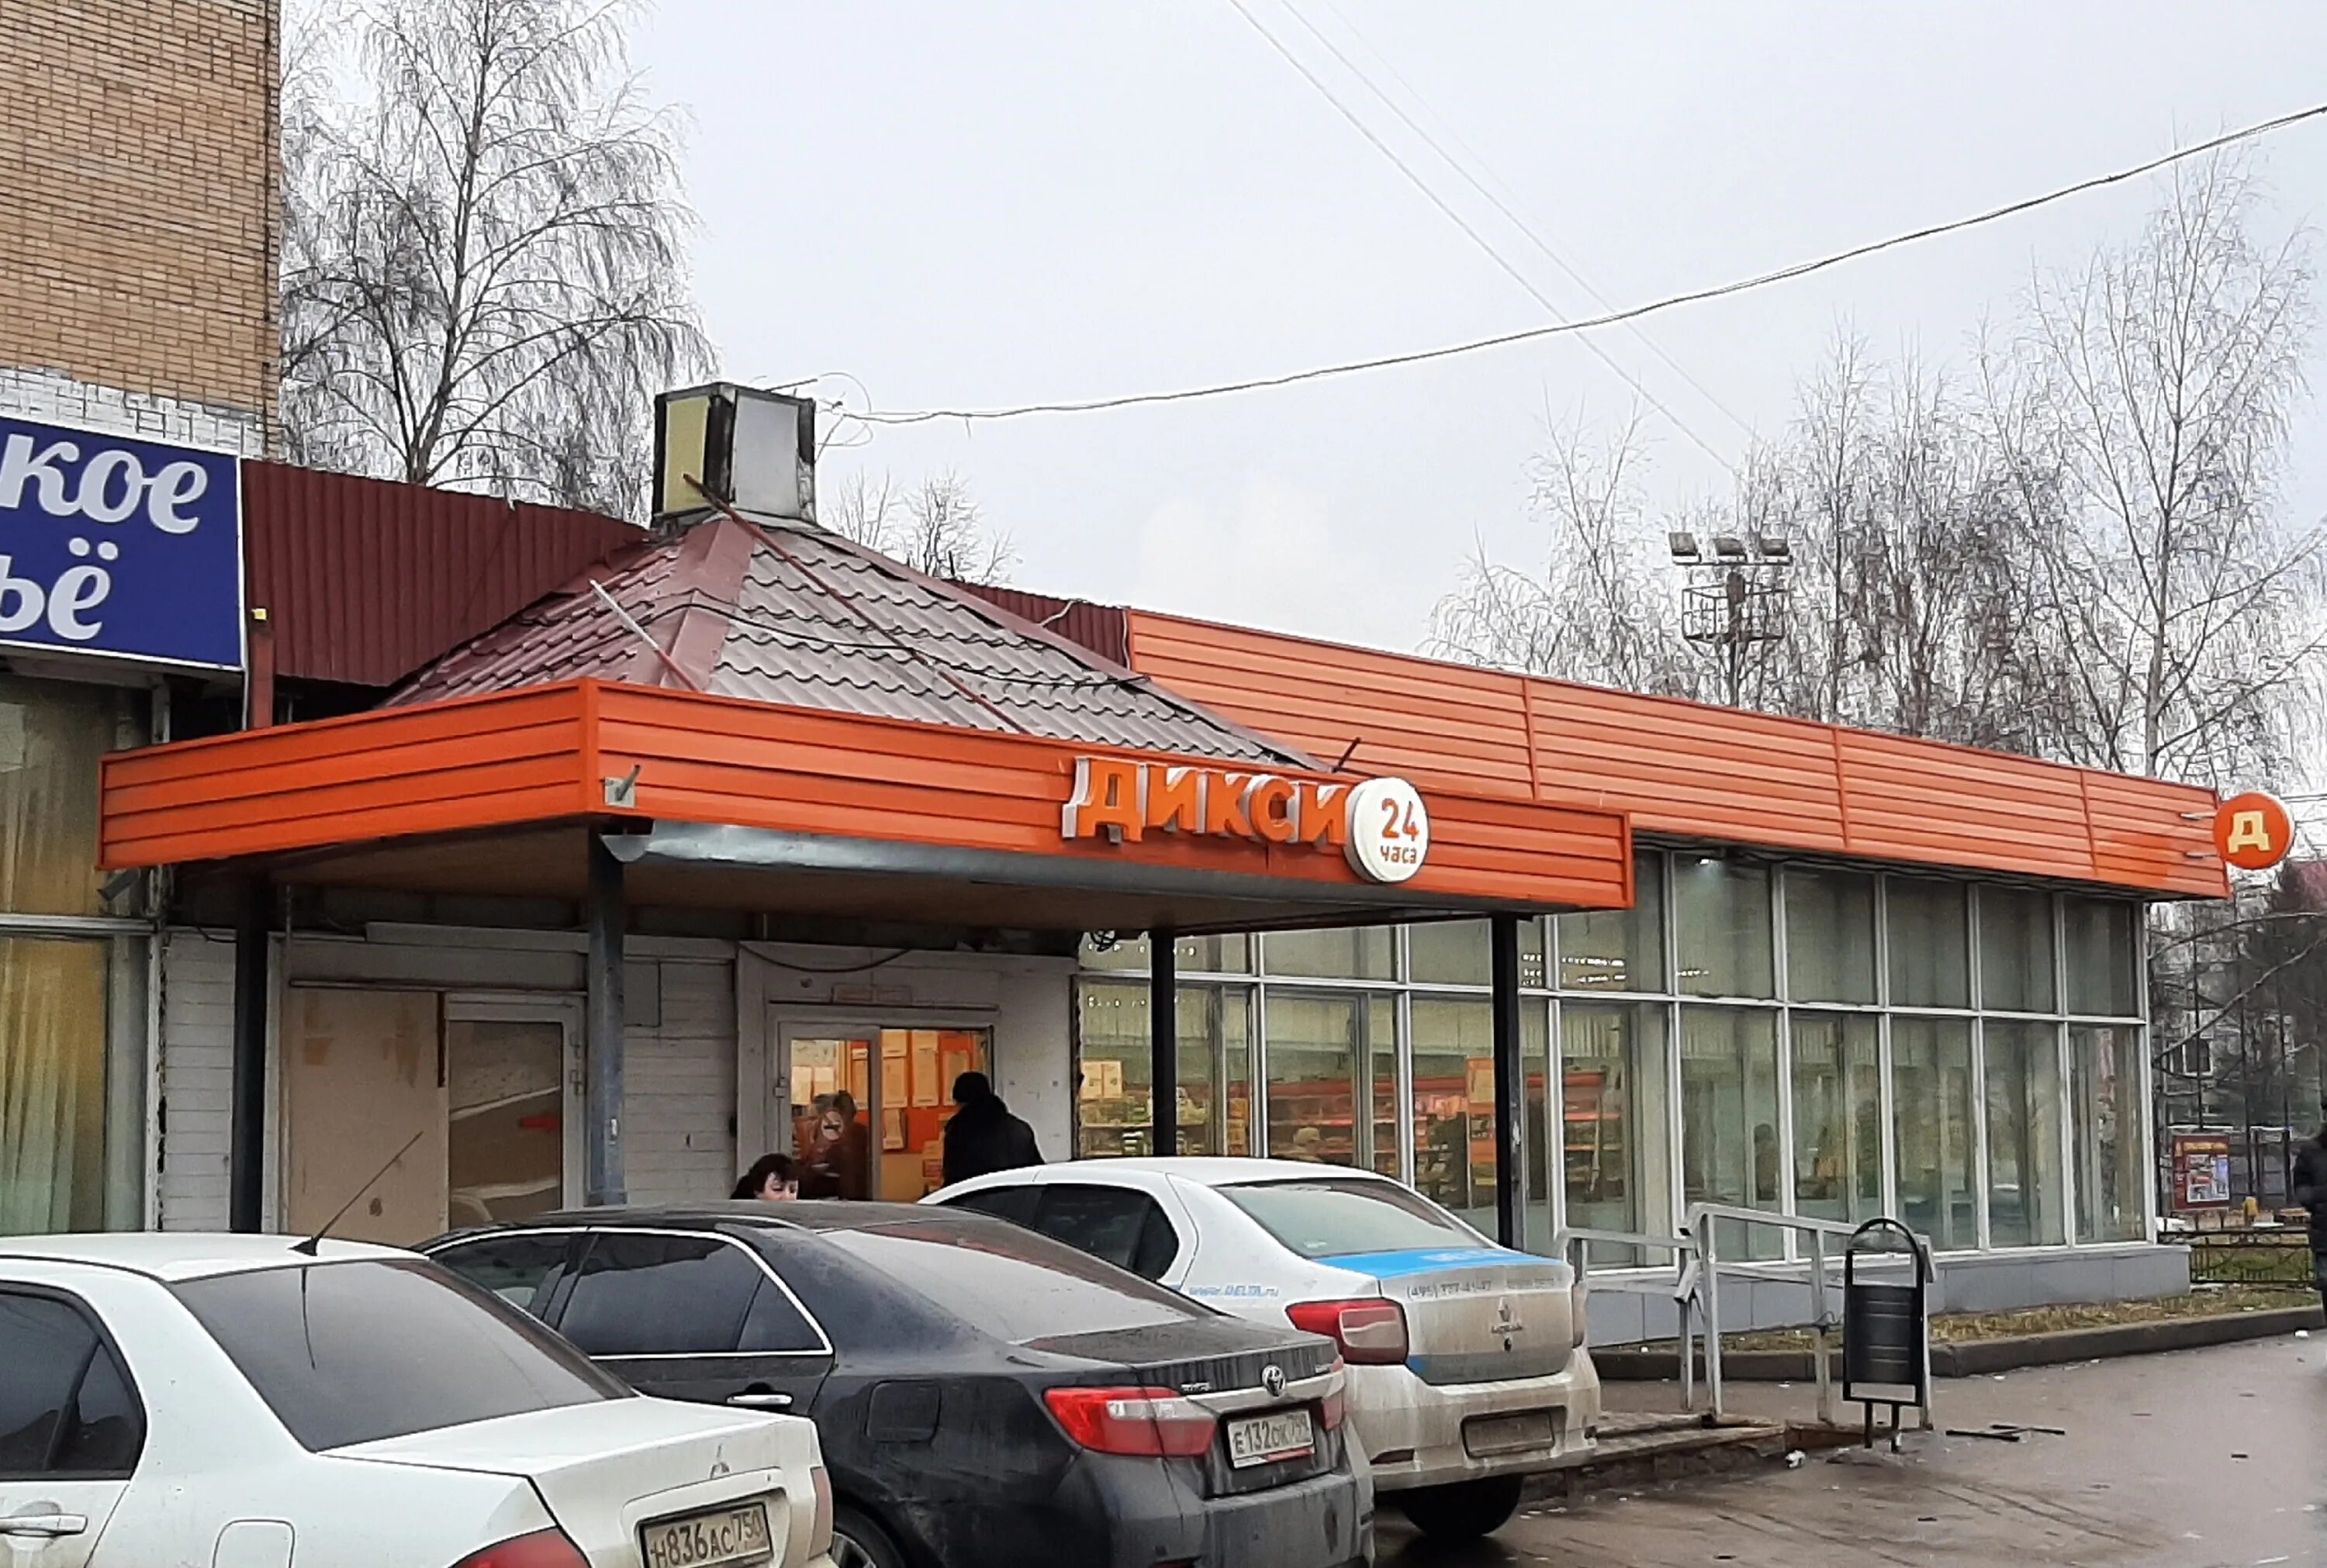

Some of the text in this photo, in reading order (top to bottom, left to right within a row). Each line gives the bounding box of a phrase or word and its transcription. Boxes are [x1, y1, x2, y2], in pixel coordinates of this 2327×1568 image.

[1063, 757, 1349, 846] ДИКСИ
[1381, 797, 1419, 841] 24
[2228, 810, 2270, 854] Д
[1380, 845, 1417, 864] часа
